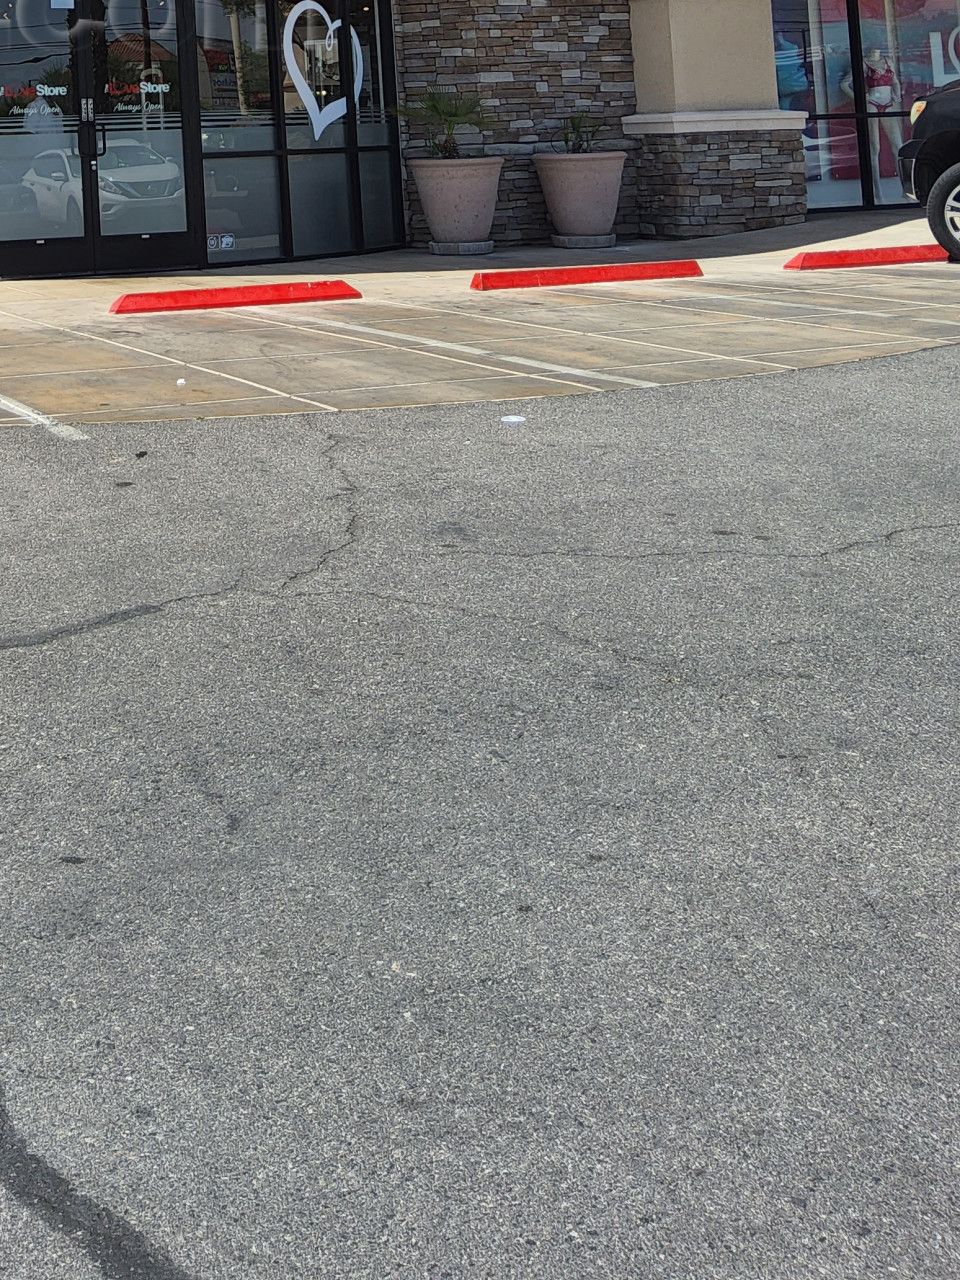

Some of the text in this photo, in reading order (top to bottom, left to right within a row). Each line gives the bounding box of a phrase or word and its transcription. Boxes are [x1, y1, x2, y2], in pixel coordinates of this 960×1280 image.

[36, 84, 68, 96] Store
[140, 80, 170, 93] Store
[8, 103, 61, 116] Always Open
[113, 100, 162, 113] Always Open
